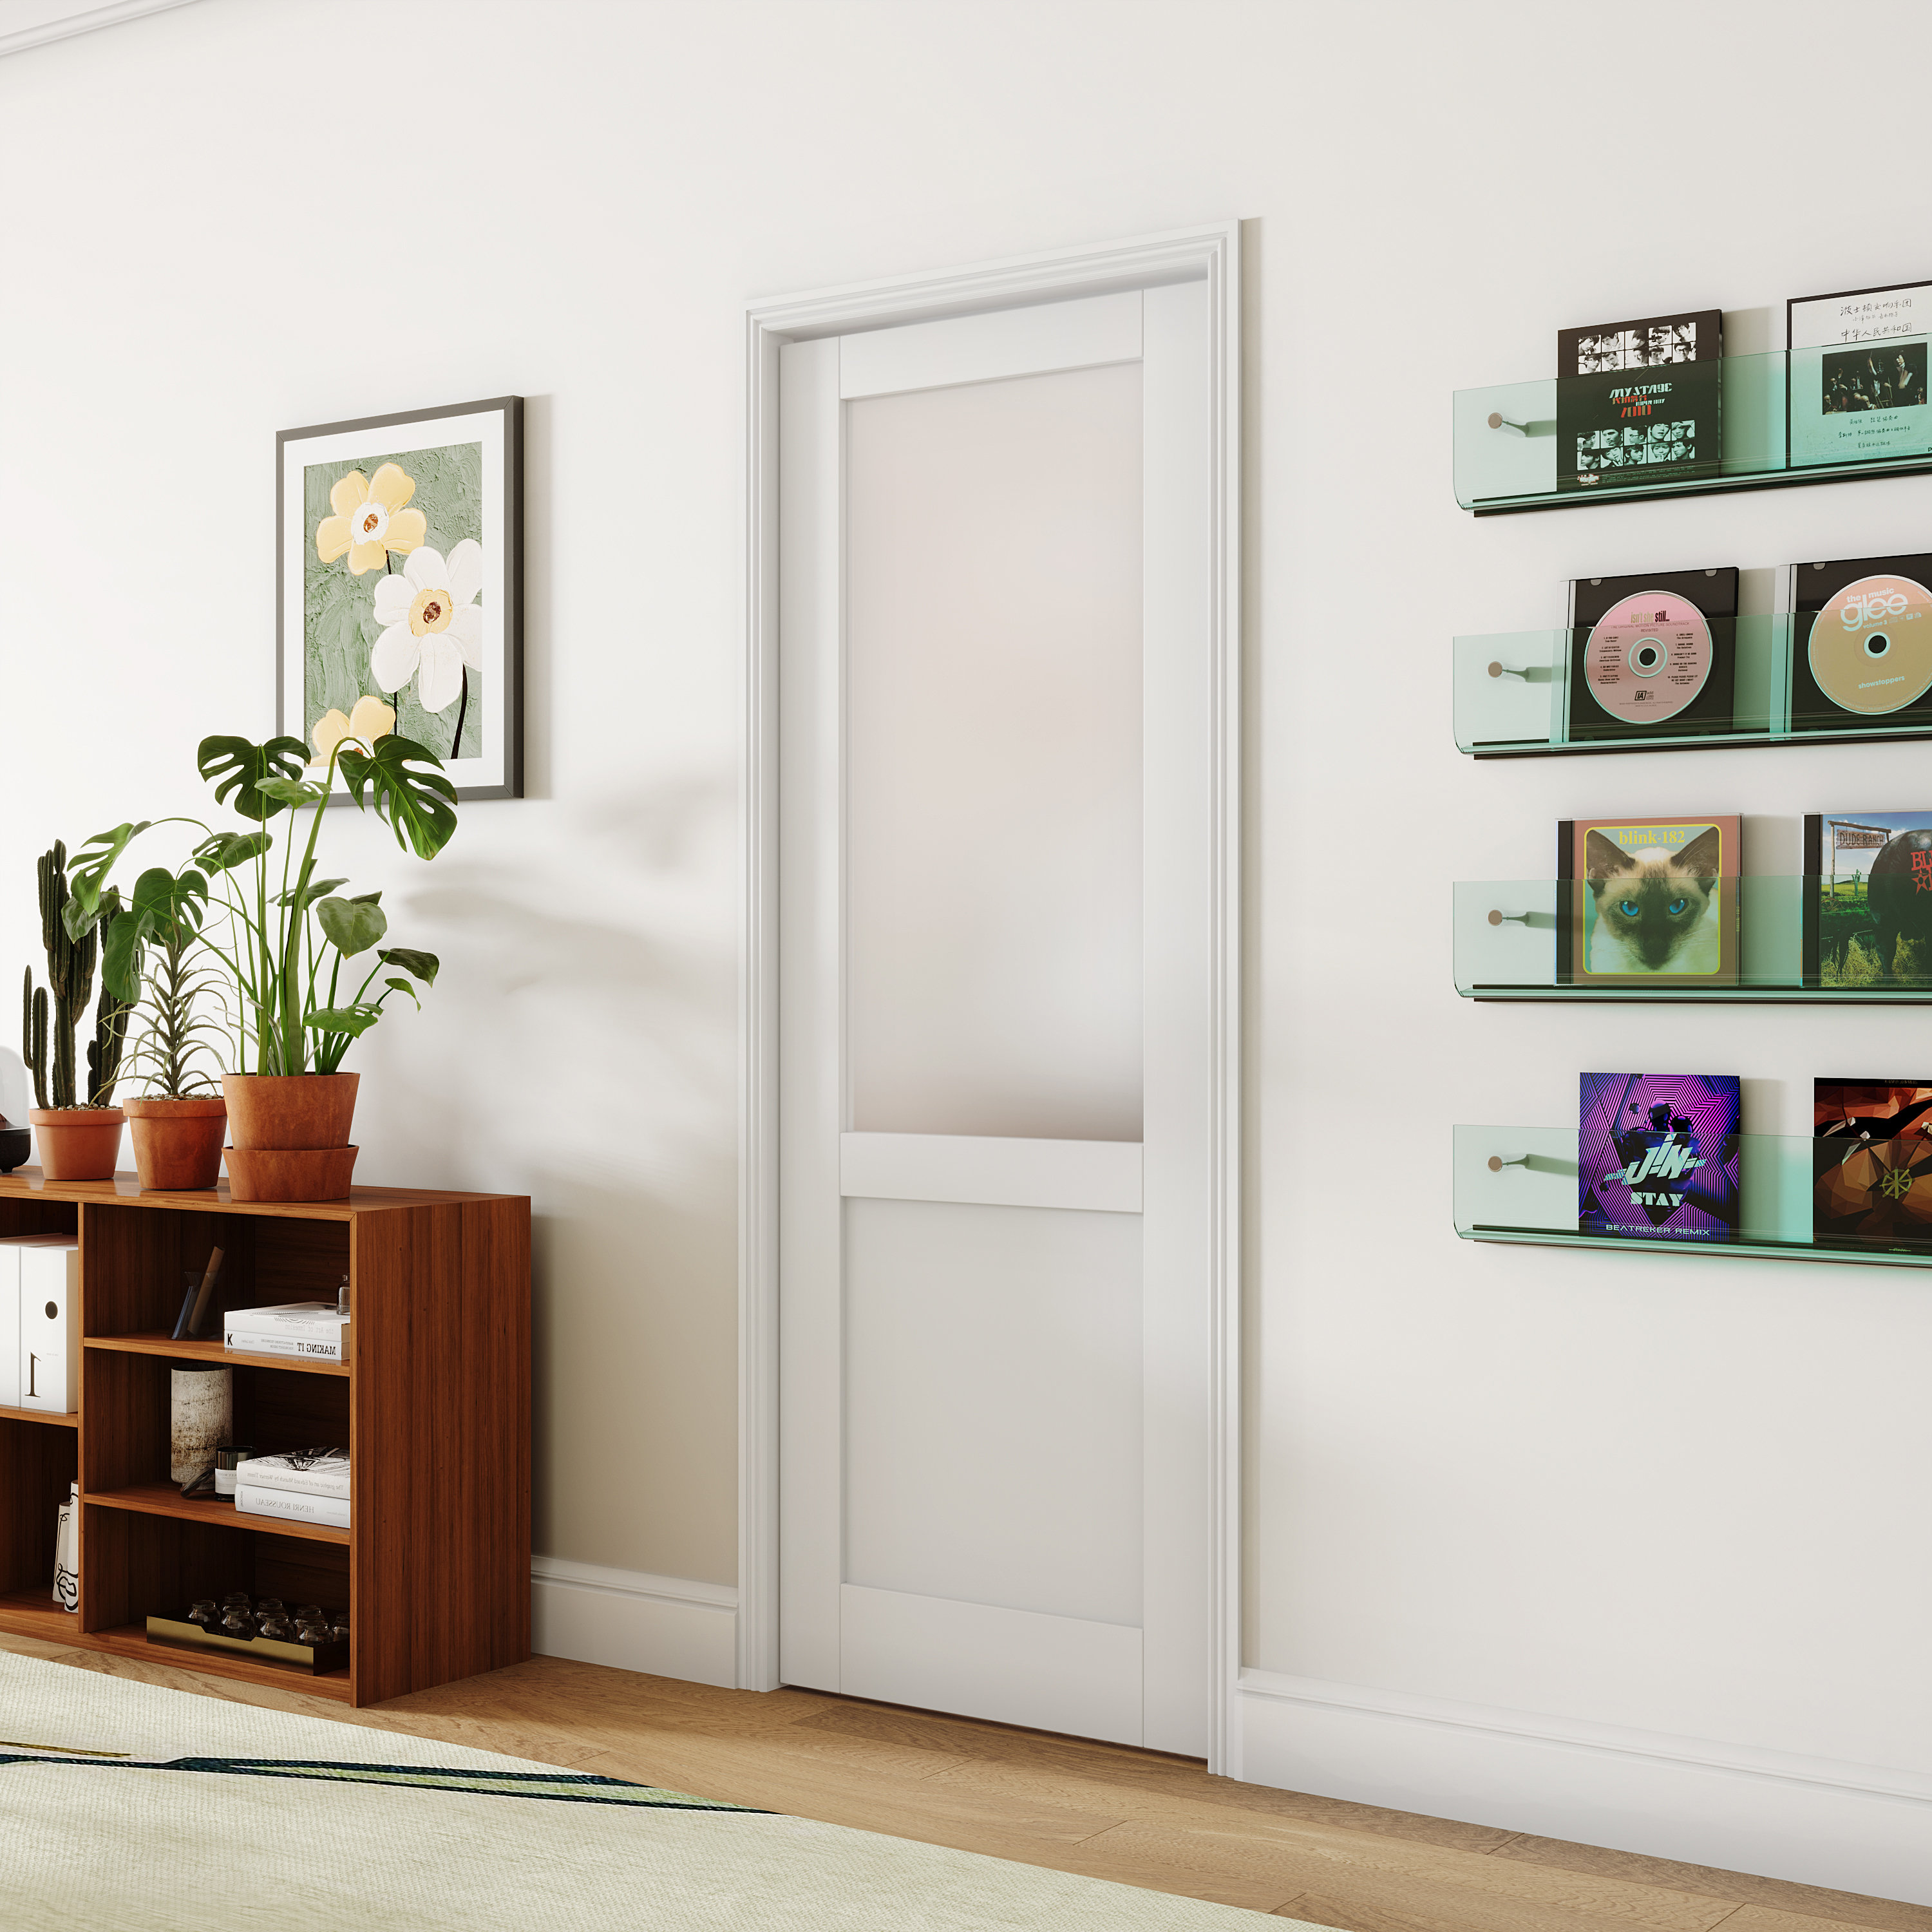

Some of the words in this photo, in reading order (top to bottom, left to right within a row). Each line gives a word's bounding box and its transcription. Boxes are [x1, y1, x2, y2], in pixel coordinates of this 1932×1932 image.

[1846, 594, 1861, 603] the
[1868, 587, 1895, 598] music
[1643, 611, 1654, 623] she
[1840, 593, 1908, 632] glee
[1862, 621, 1883, 629] volume
[1858, 676, 1905, 690] showstoppers
[1619, 830, 1685, 845] blink-182
[1839, 832, 1861, 846] DUDE
[1862, 834, 1884, 846] RANCH
[1631, 1191, 1683, 1207] STAY
[1605, 1224, 1671, 1233] BEATREKER
[227, 1333, 233, 1346] K
